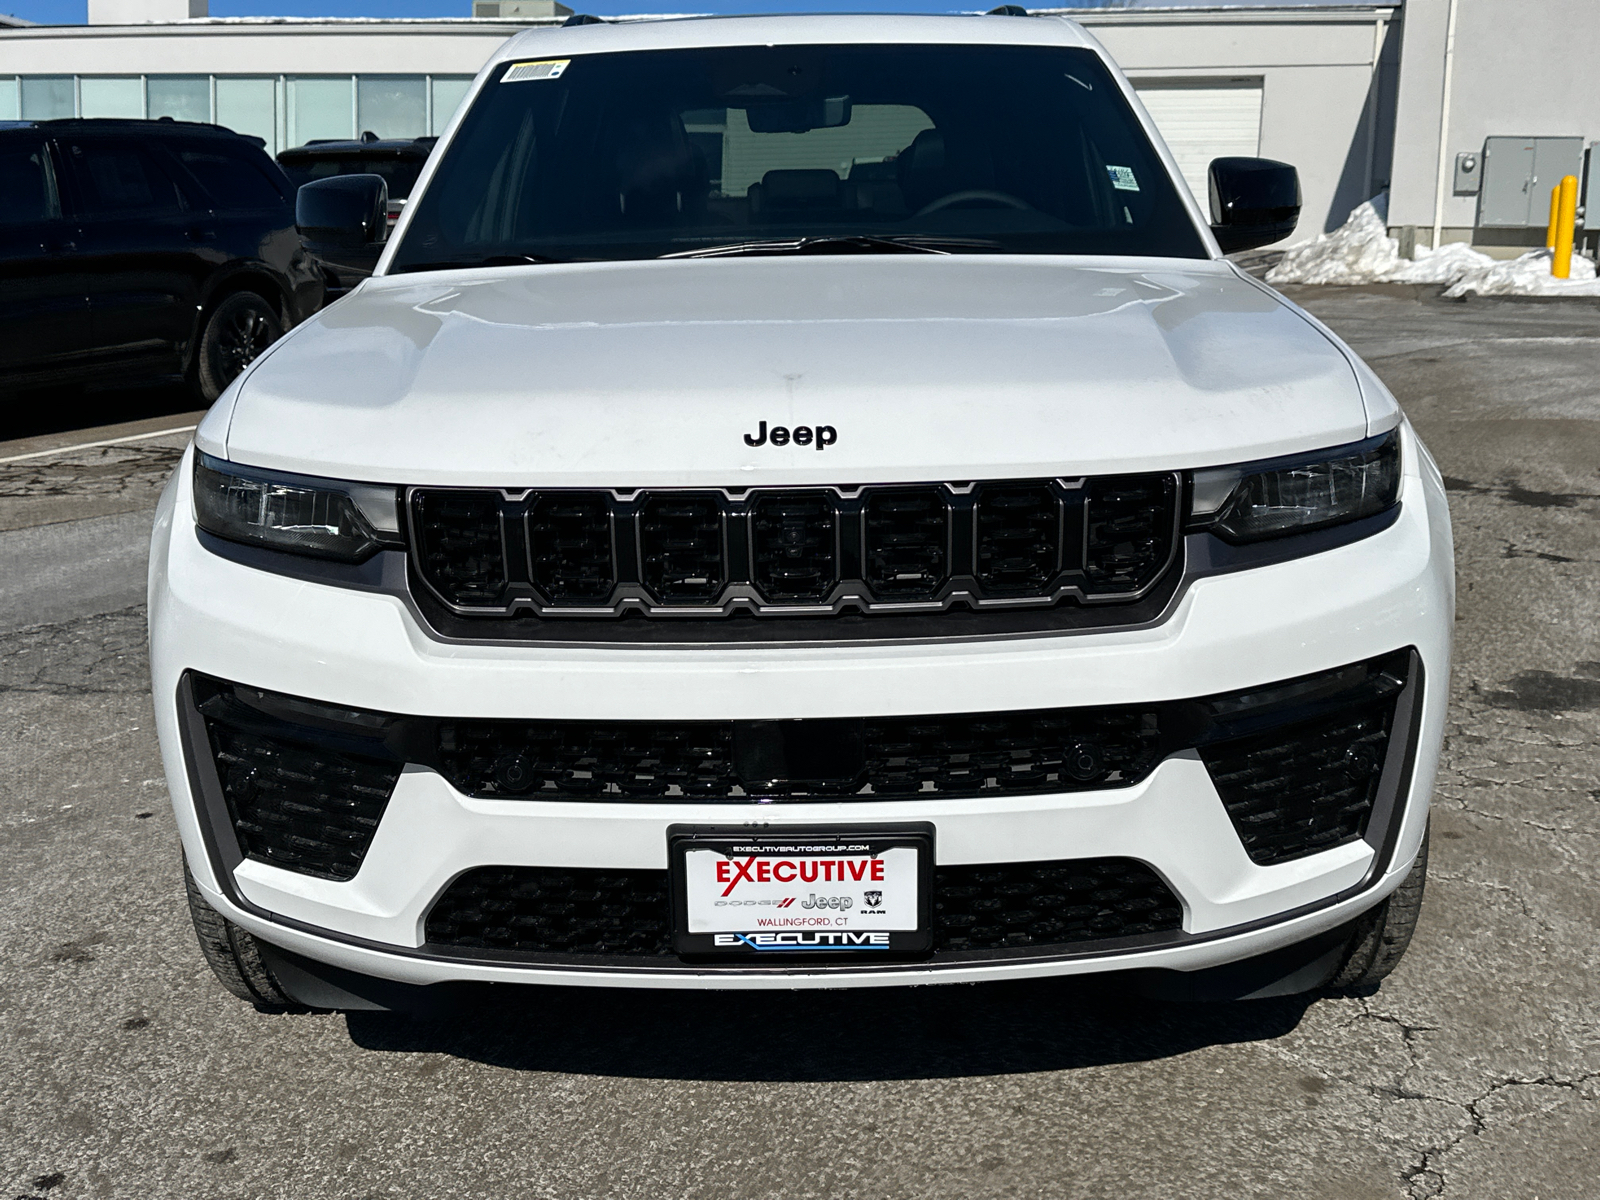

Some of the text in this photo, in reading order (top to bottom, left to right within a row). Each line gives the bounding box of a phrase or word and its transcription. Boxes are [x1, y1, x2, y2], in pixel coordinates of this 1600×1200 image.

[743, 421, 837, 451] Jeep
[733, 845, 869, 853] EXECUTIVEAUTOGROUP.COM
[716, 856, 885, 897] EXECUTIVE
[801, 893, 853, 911] Jeep
[757, 917, 848, 927] WALLINGFORD, CT
[714, 932, 890, 949] EXECUTIVE
